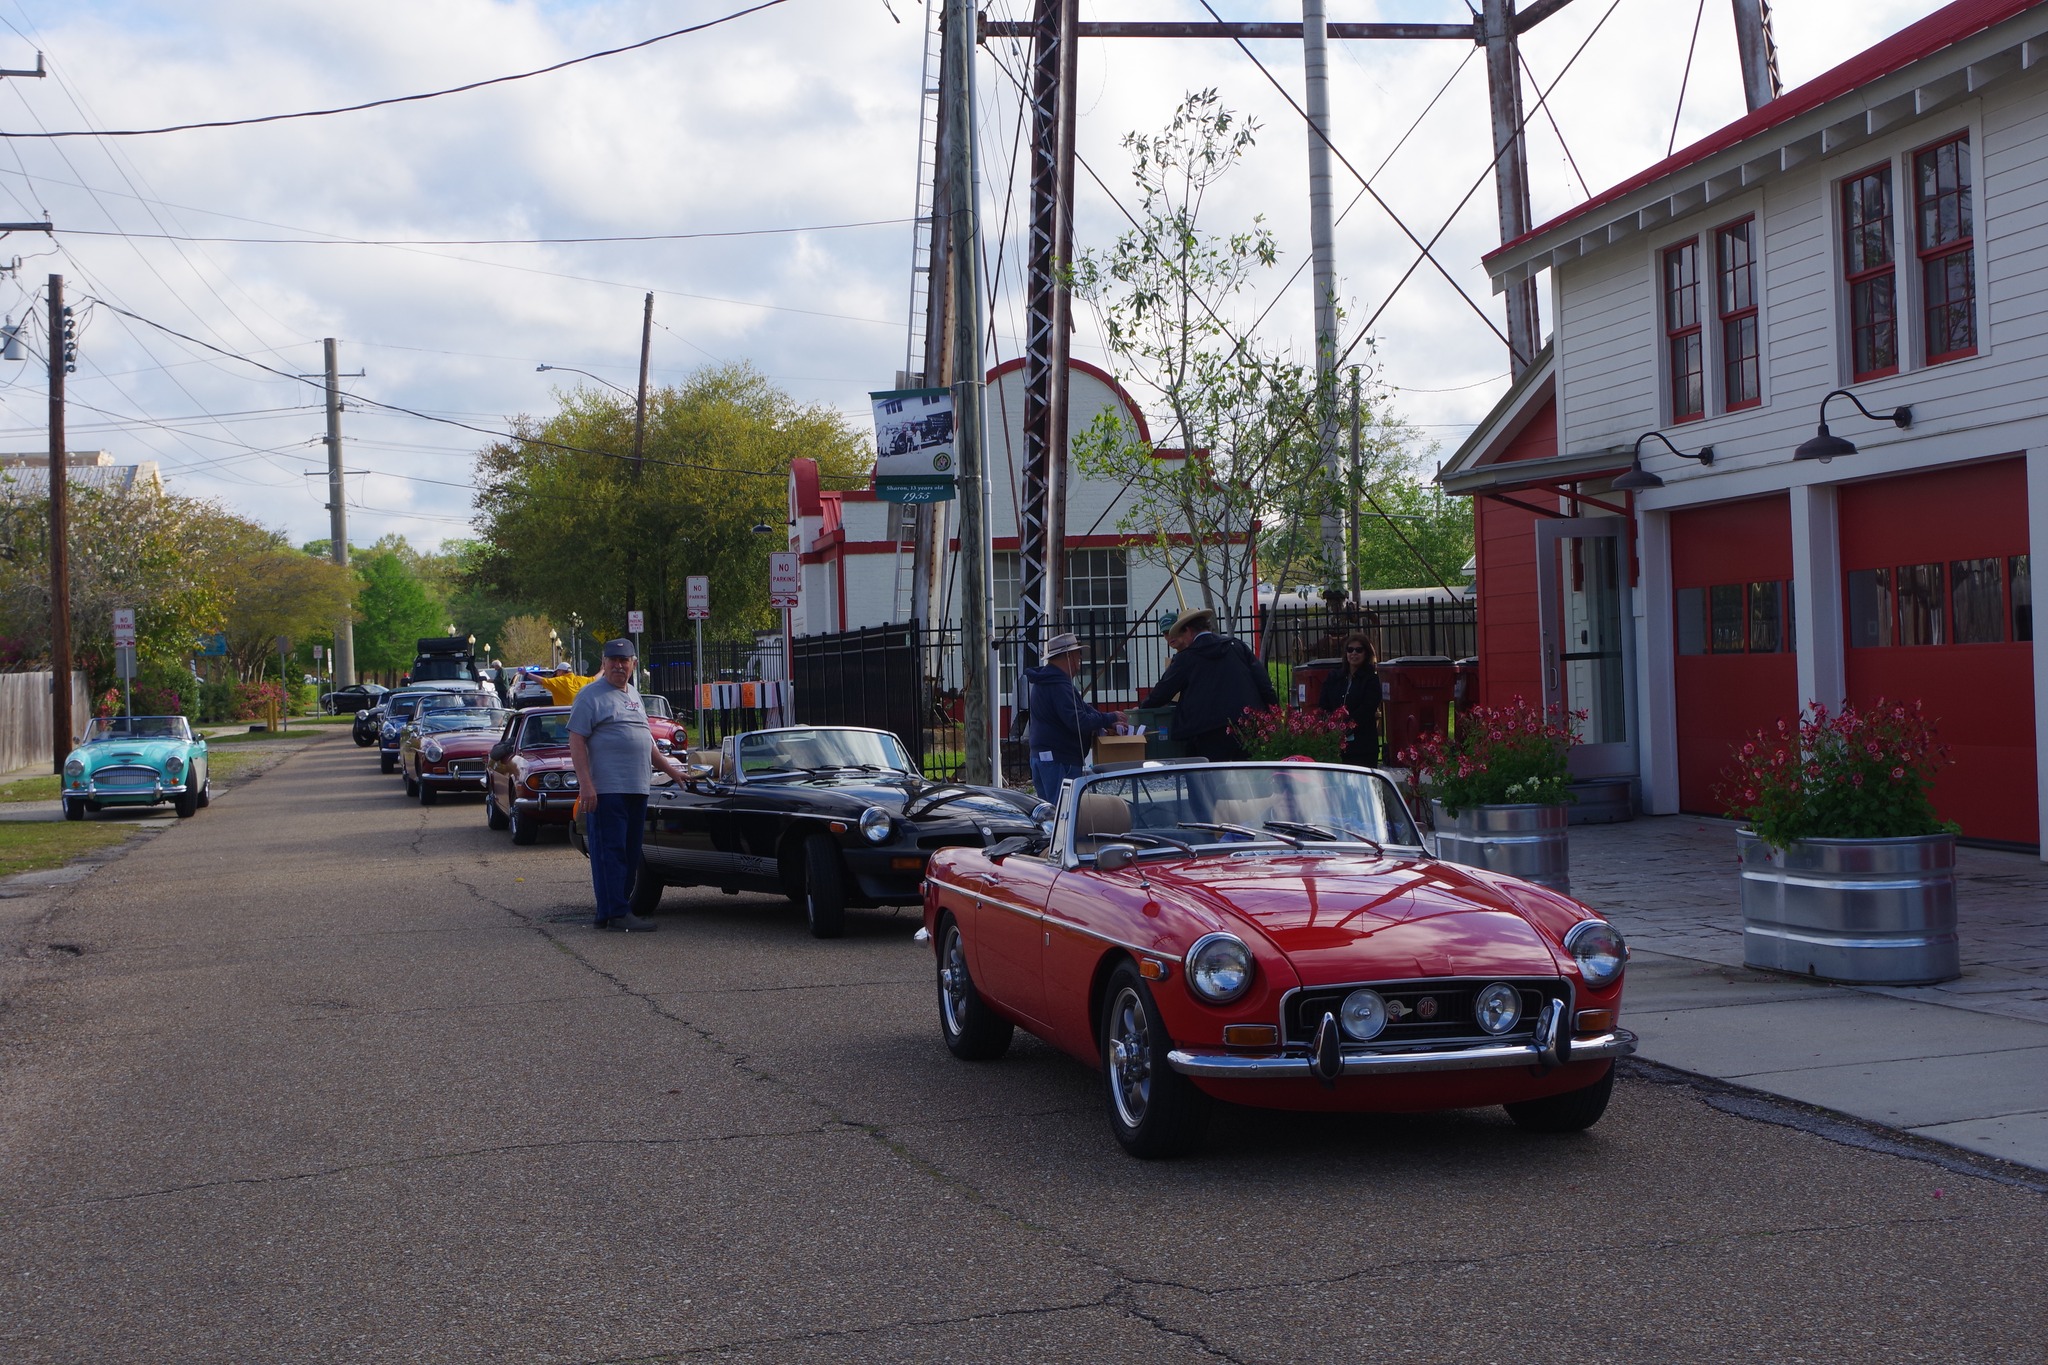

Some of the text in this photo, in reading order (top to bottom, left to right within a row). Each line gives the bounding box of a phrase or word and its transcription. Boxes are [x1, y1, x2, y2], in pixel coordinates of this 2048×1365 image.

[902, 492, 931, 502] 1955
[778, 563, 790, 572] NO
[1420, 1001, 1435, 1016] MG
